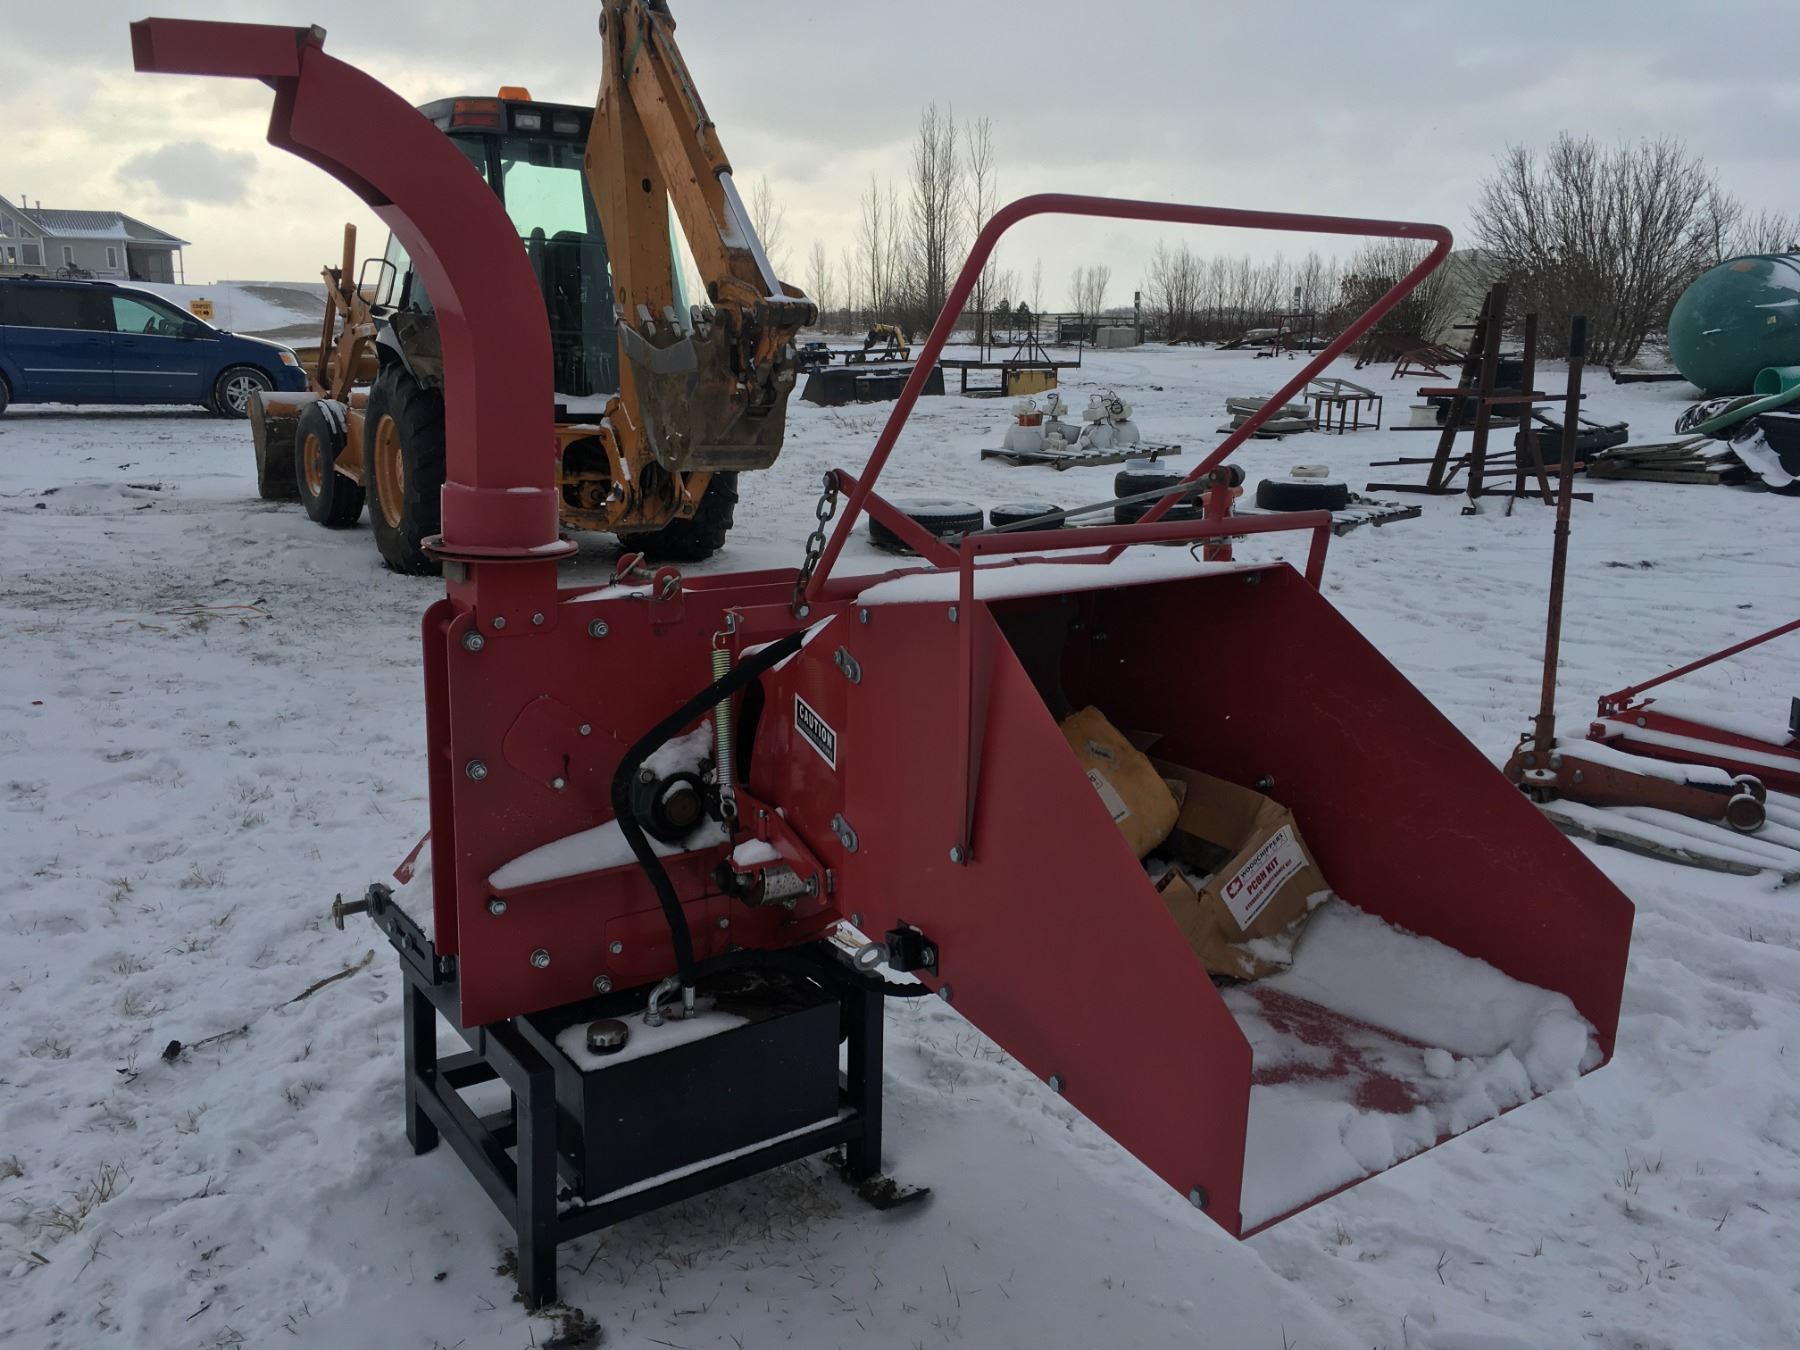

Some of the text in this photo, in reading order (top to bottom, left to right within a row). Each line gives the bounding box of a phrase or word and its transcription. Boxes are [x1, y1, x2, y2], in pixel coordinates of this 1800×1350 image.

[799, 704, 833, 749] CAUTION
[1240, 832, 1284, 878] WOODCHIPPERS
[1267, 857, 1279, 874] KIT
